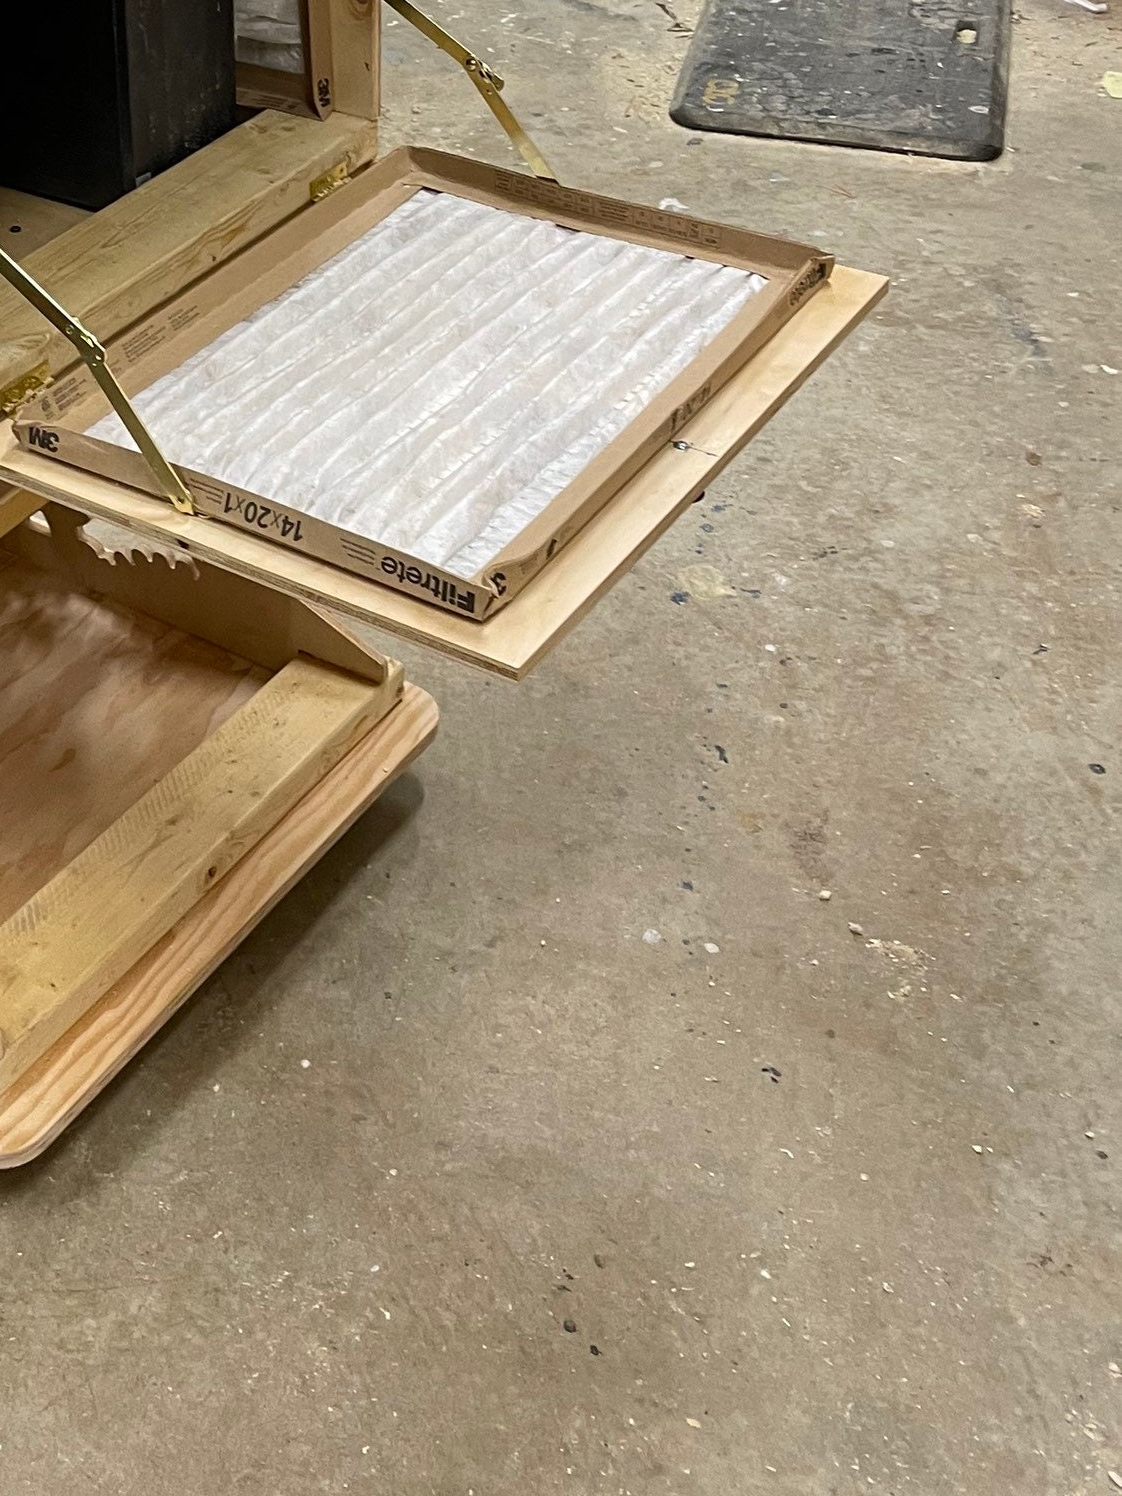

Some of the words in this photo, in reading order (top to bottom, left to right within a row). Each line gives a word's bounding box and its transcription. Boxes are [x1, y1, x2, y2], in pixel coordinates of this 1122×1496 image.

[318, 78, 331, 108] 3M
[28, 426, 60, 453] 3M
[223, 492, 303, 541] 14x20x1
[380, 556, 476, 613] Filtrete
